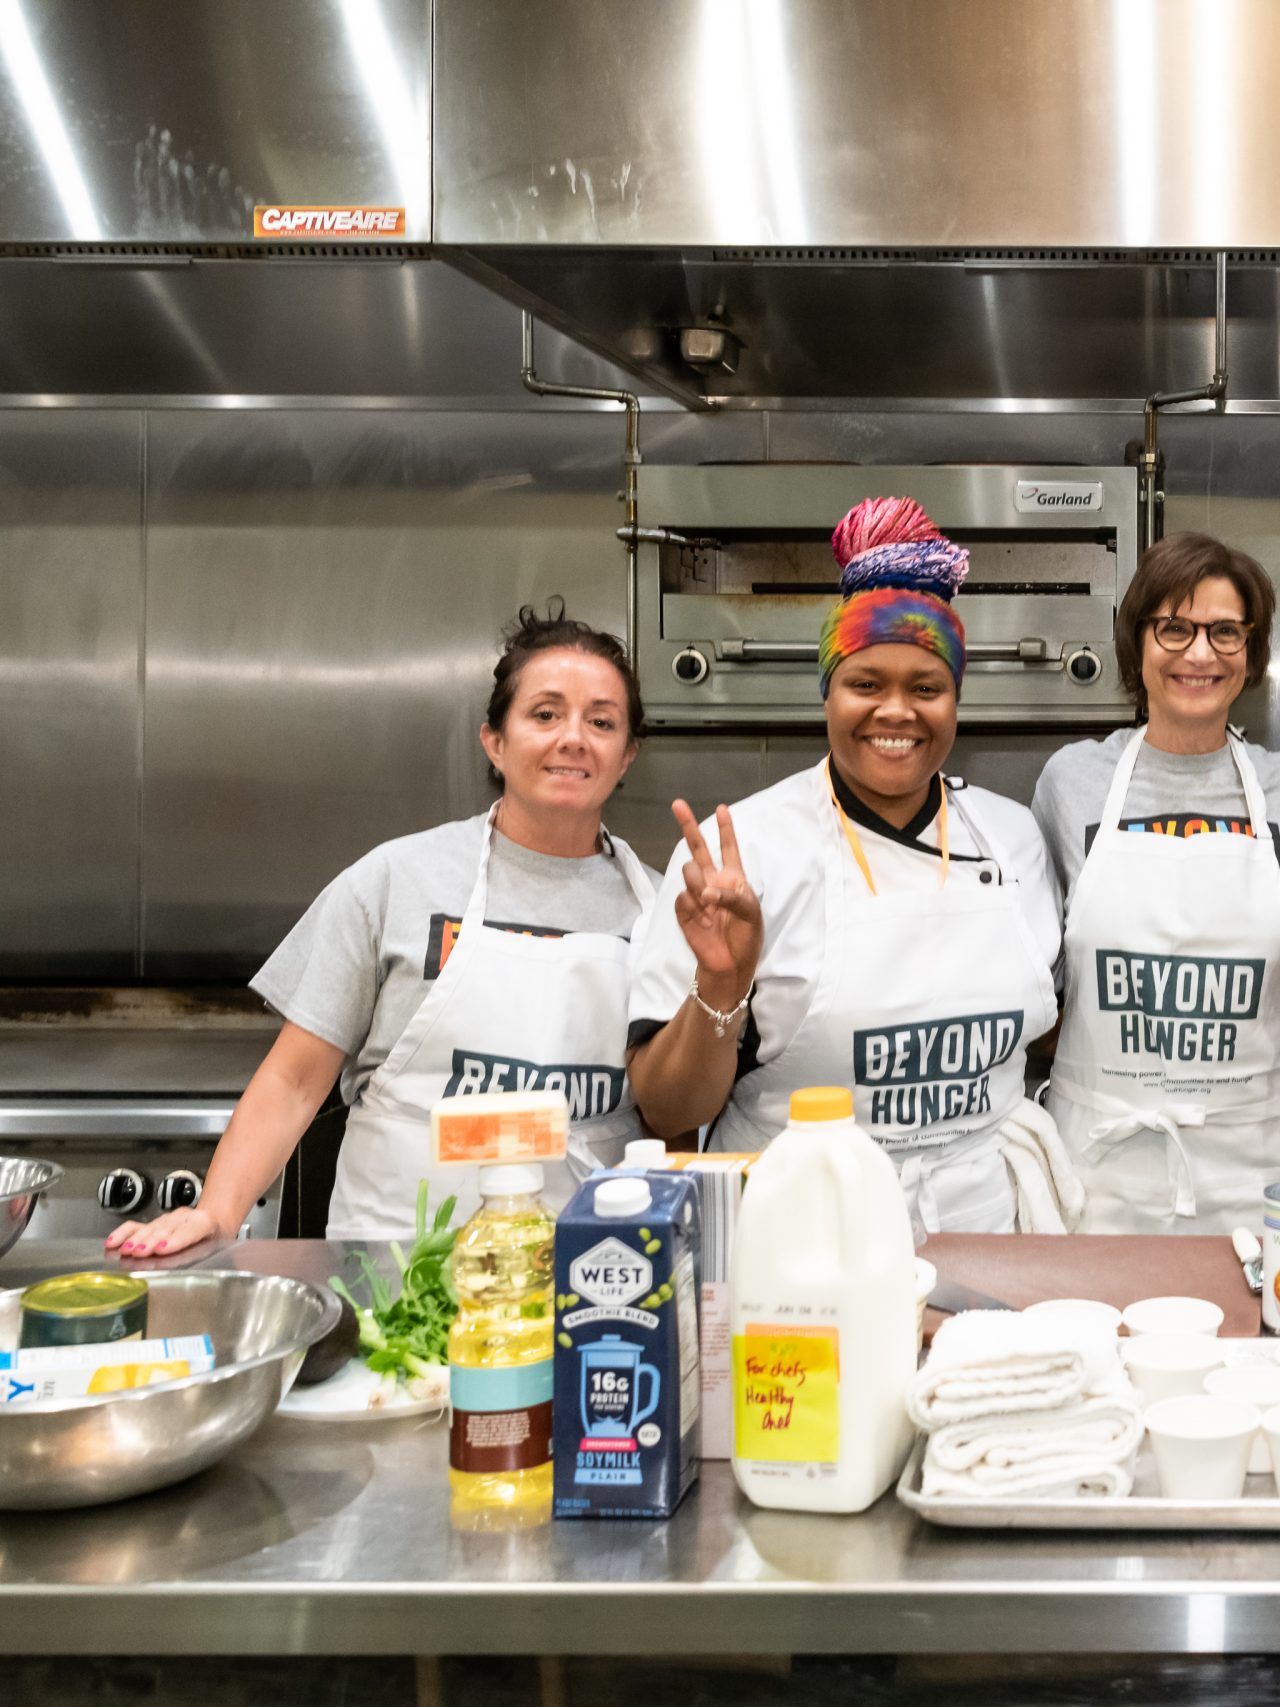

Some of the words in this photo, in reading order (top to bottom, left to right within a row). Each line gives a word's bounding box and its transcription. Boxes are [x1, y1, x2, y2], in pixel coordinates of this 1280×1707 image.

[1037, 492, 1092, 505] Garland
[1106, 957, 1255, 1015] BEYOND
[865, 1018, 1016, 1081] BEYOND
[871, 1074, 991, 1128] HUNGER
[581, 1268, 643, 1283] WEST
[601, 1288, 623, 1296] LIFE
[568, 1309, 621, 1325] SMOOTHIE
[625, 1310, 656, 1326] BLEND
[746, 1356, 768, 1377] For
[592, 1372, 629, 1392] 16G
[590, 1392, 629, 1404] PROTEIN
[746, 1384, 794, 1416] Healthy
[577, 1452, 641, 1468] SOYMILK
[591, 1472, 627, 1480] PLAIN
